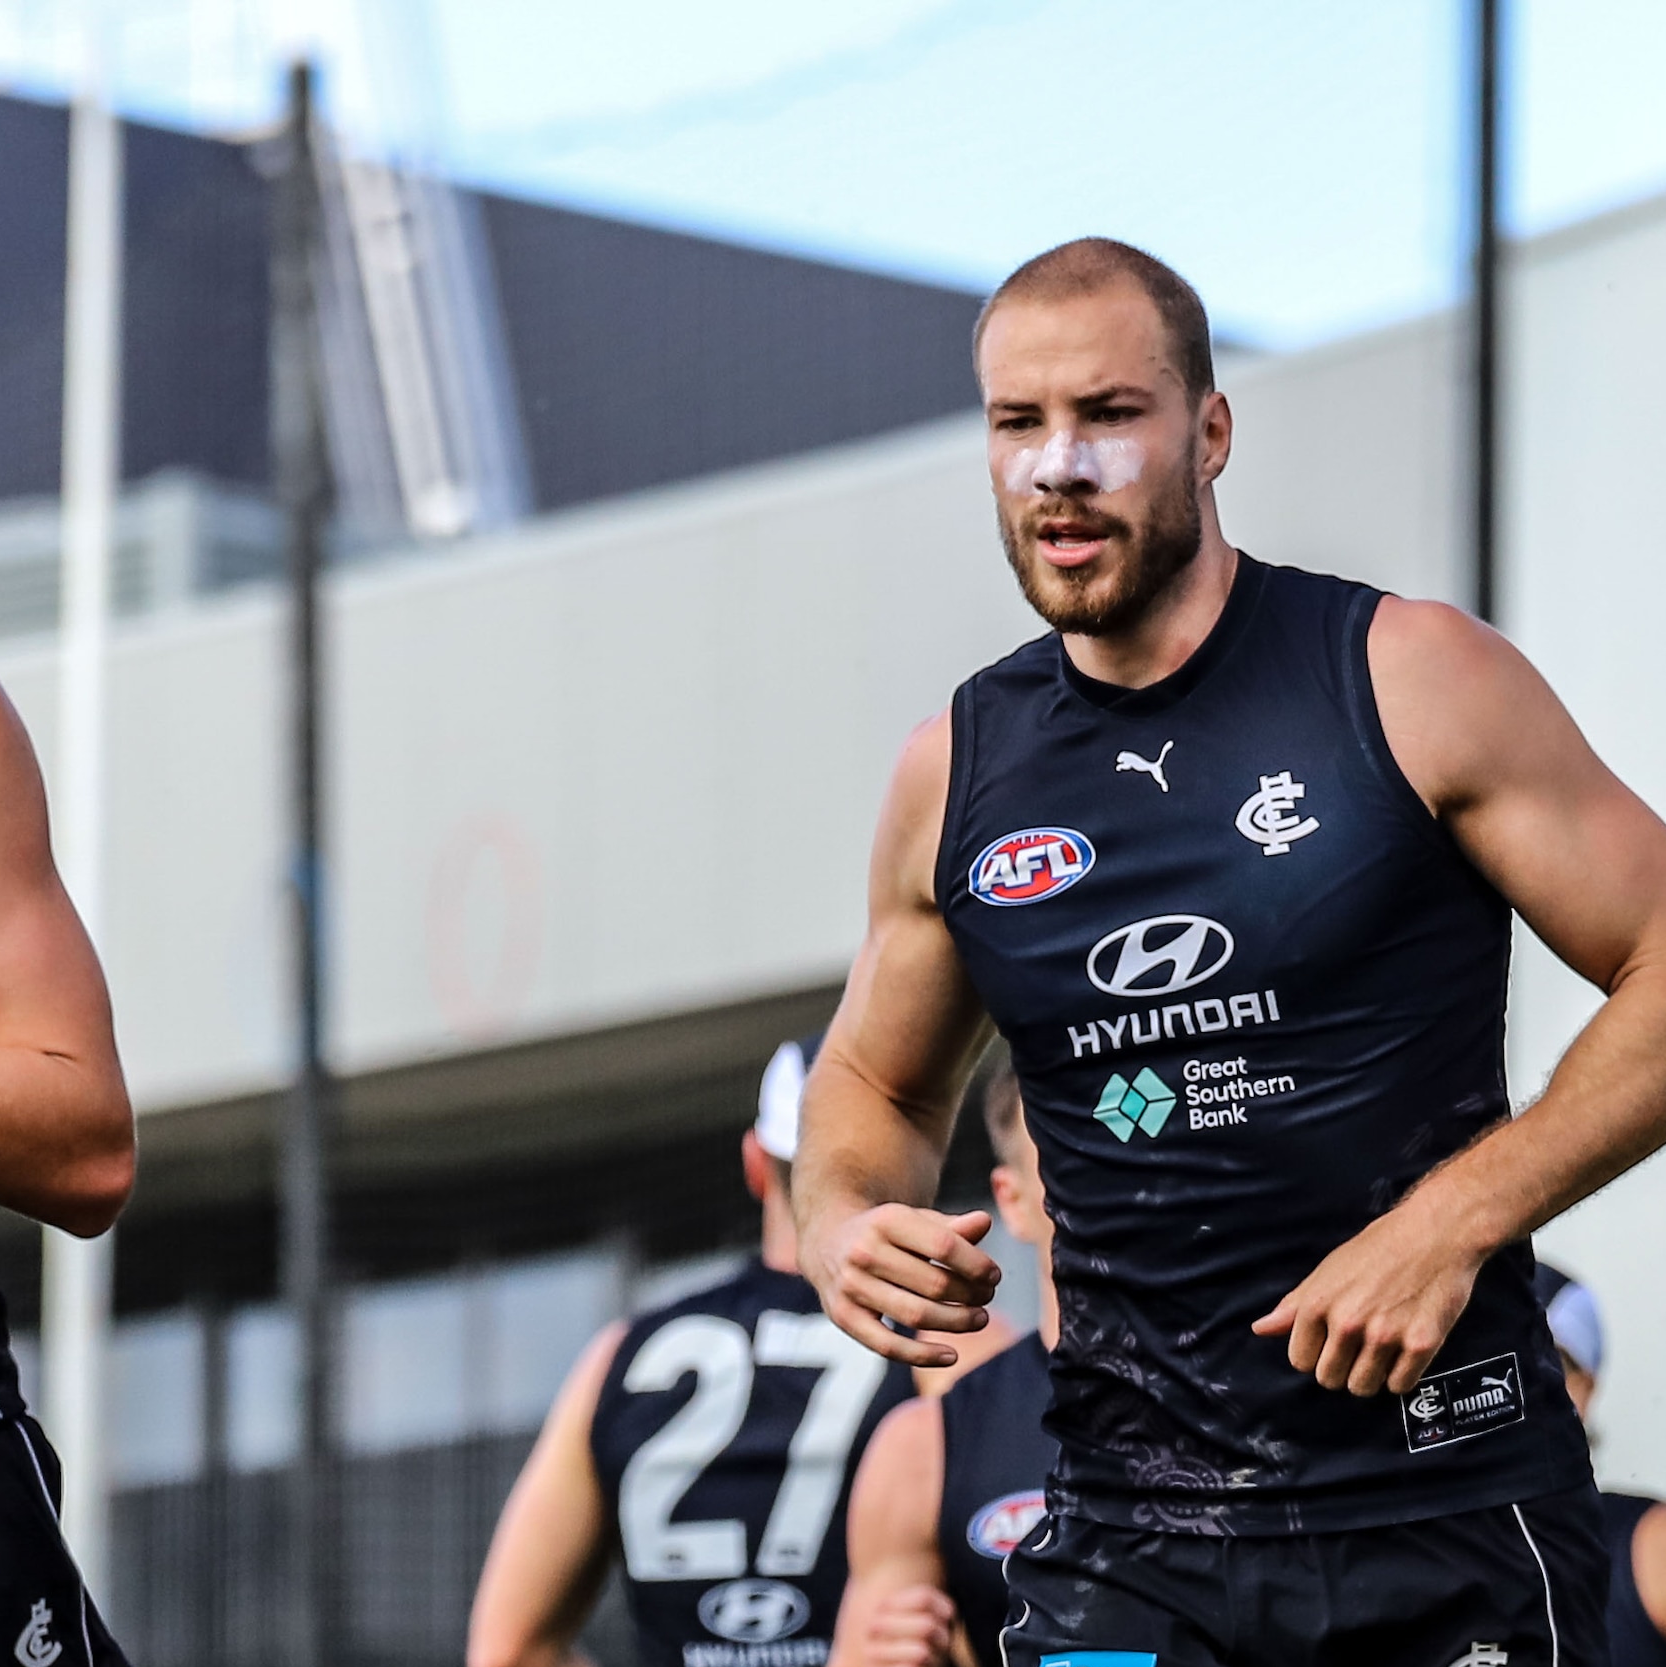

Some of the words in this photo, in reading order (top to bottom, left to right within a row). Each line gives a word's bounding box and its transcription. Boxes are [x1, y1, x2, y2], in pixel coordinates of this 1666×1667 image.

[978, 840, 1084, 893] AFL
[1067, 990, 1281, 1058] HYUNDAI
[1183, 1056, 1248, 1082] Great
[1185, 1075, 1296, 1106] Southern
[1189, 1103, 1248, 1131] Bank
[1453, 1387, 1505, 1416] PUMA
[619, 1309, 889, 1582] 27
